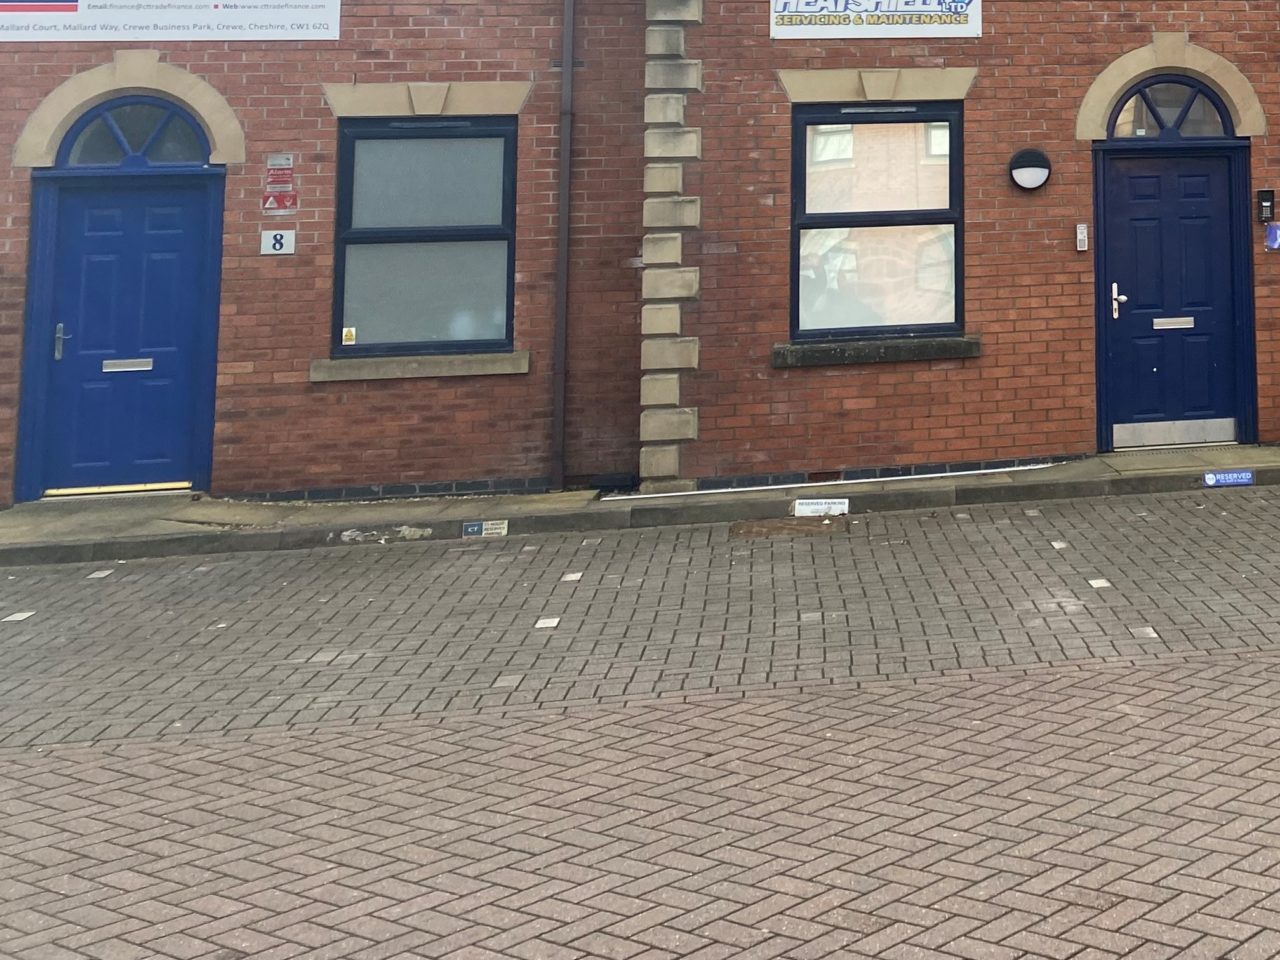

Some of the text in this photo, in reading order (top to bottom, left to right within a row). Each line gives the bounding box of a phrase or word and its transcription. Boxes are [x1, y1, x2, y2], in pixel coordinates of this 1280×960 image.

[942, 1, 967, 13] LTD
[775, 14, 968, 26] SERVICING & MAINTENANCE
[33, 23, 60, 32] Court,
[63, 23, 97, 31] Mallard
[122, 23, 150, 31] Crewe
[153, 23, 190, 31] Business
[193, 23, 214, 32] Park,
[216, 23, 246, 32] Crewe,
[249, 23, 288, 32] Cheshire,
[290, 23, 309, 31] CW1
[272, 233, 284, 251] 8
[1216, 472, 1252, 480] RESERVED
